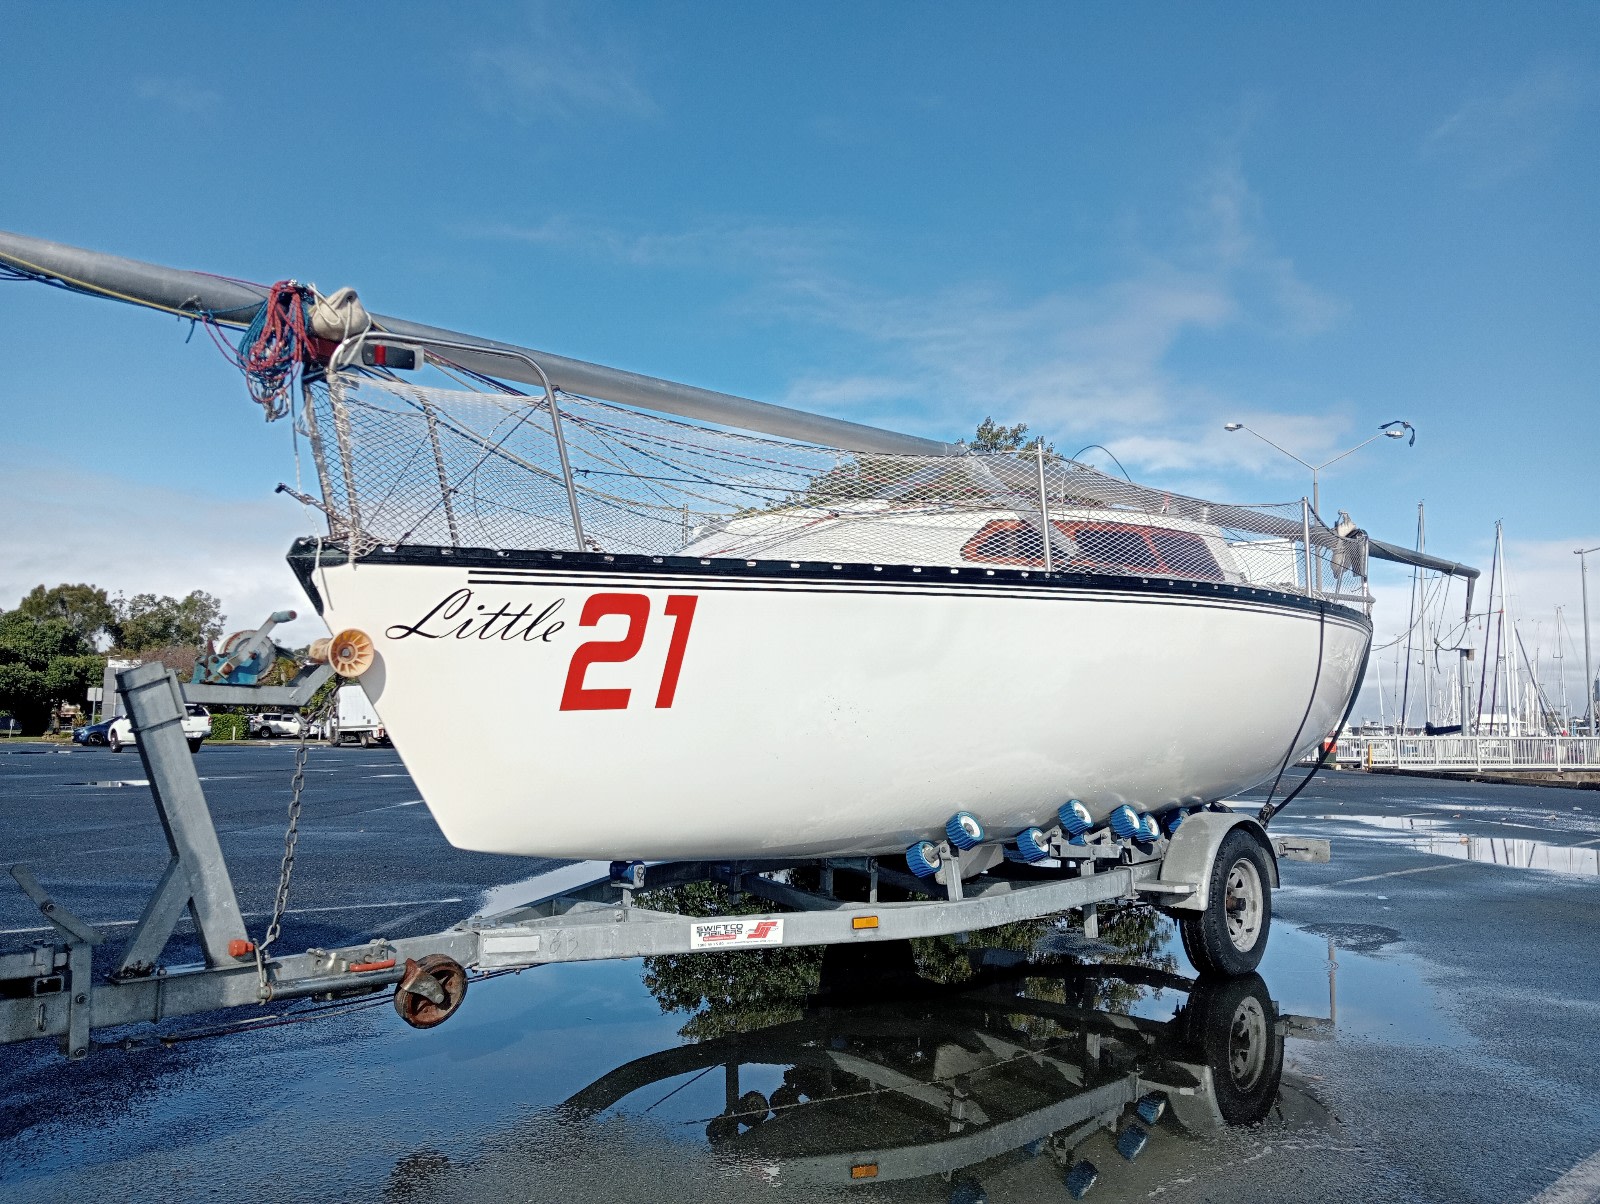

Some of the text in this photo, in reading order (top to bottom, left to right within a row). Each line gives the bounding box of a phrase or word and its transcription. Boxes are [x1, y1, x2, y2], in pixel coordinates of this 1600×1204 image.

[385, 588, 699, 711] Little 21
[696, 924, 744, 932] SWIFTCO
